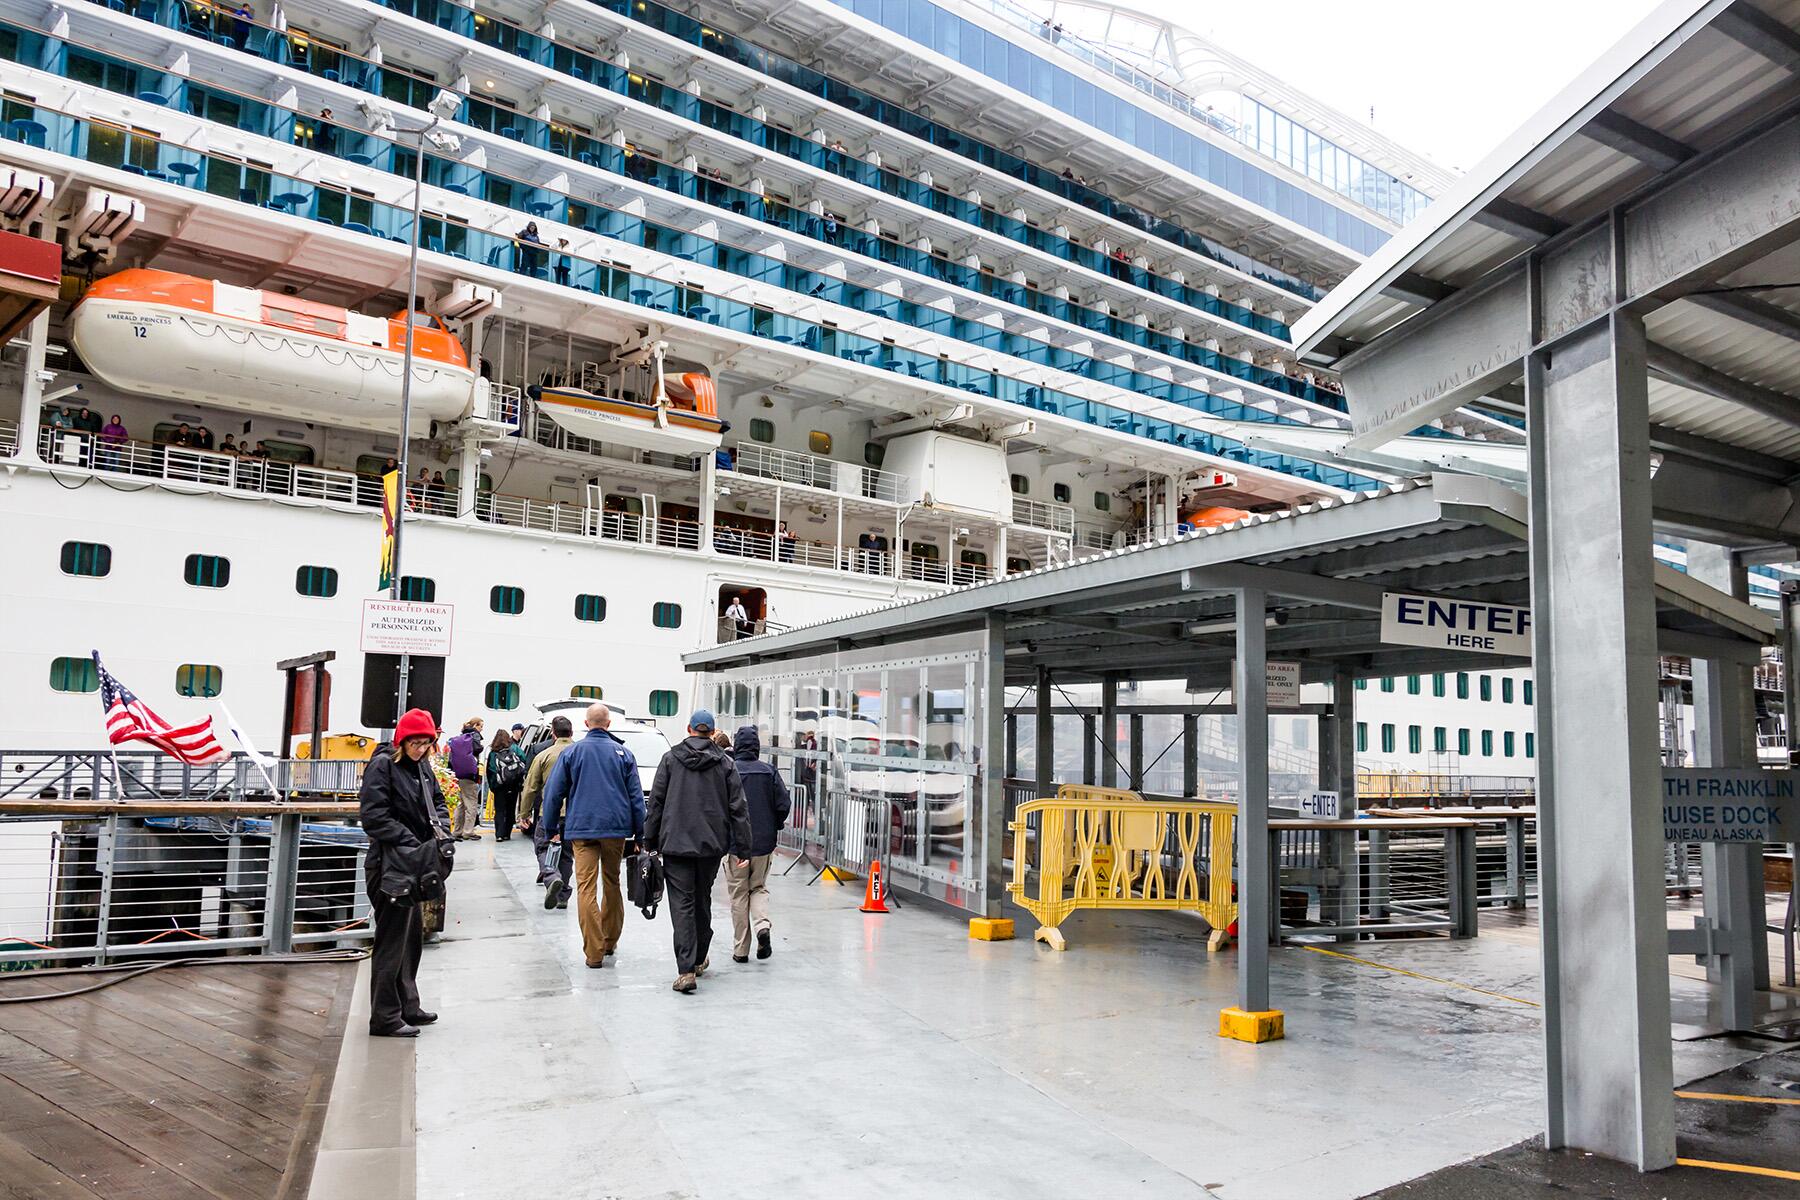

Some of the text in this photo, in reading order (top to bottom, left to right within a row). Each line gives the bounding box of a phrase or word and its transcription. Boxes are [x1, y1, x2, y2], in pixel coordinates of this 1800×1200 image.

[106, 313, 138, 321] EMERALD
[140, 316, 172, 325] PRINCESS
[134, 326, 147, 338] 12
[370, 603, 447, 615] RESTRICTED AREA
[371, 622, 418, 631] PERSONNEL
[381, 616, 435, 626] AUTHORIZED
[1447, 633, 1495, 650] HERE
[1697, 779, 1793, 797] FRANKLIN
[1312, 794, 1336, 816] ENTER
[1722, 806, 1782, 824] DOCK
[1664, 828, 1764, 840] UNEAU ALASKA
